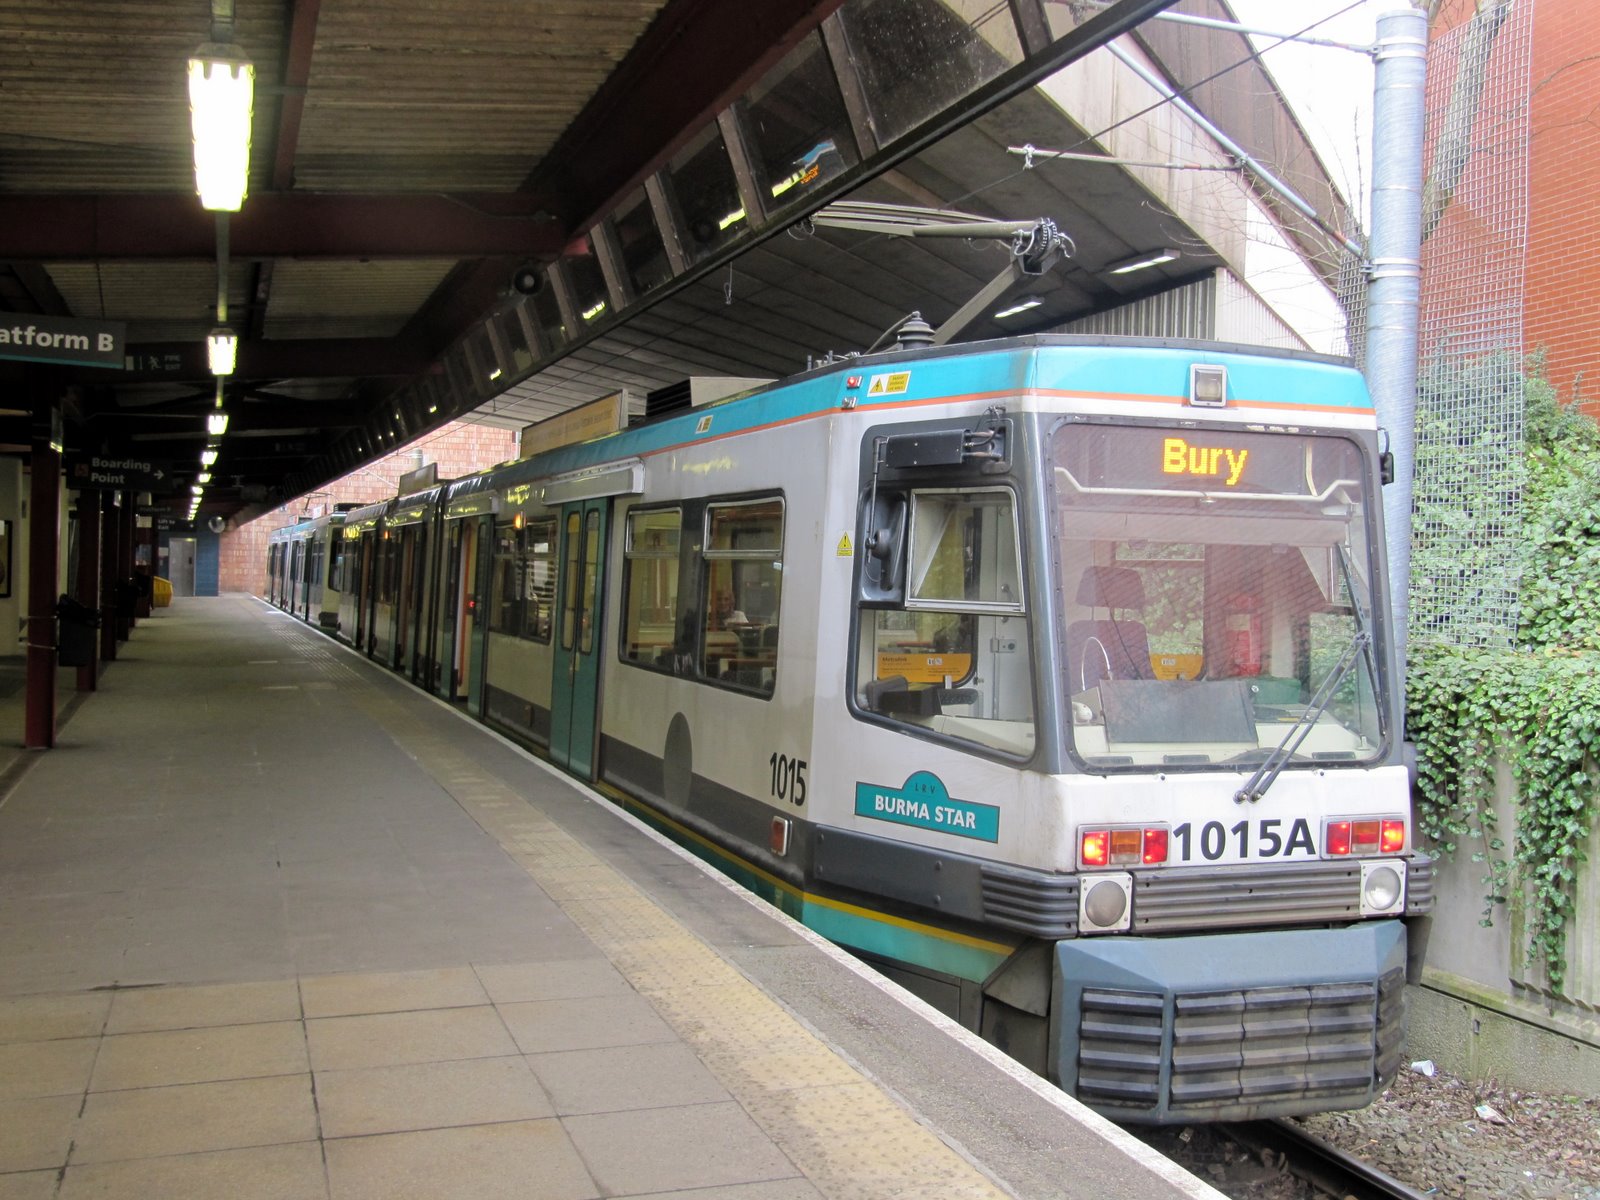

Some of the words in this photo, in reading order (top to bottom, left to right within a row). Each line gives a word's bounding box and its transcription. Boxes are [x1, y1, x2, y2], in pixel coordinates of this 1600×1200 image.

[98, 333, 114, 352] B
[91, 457, 151, 472] Boarding
[91, 472, 125, 484] Point
[1163, 438, 1247, 486] Bury
[770, 752, 807, 807] 1015
[875, 794, 930, 821] BURMA
[935, 806, 976, 829] STAR
[1172, 818, 1316, 861] 1015A
